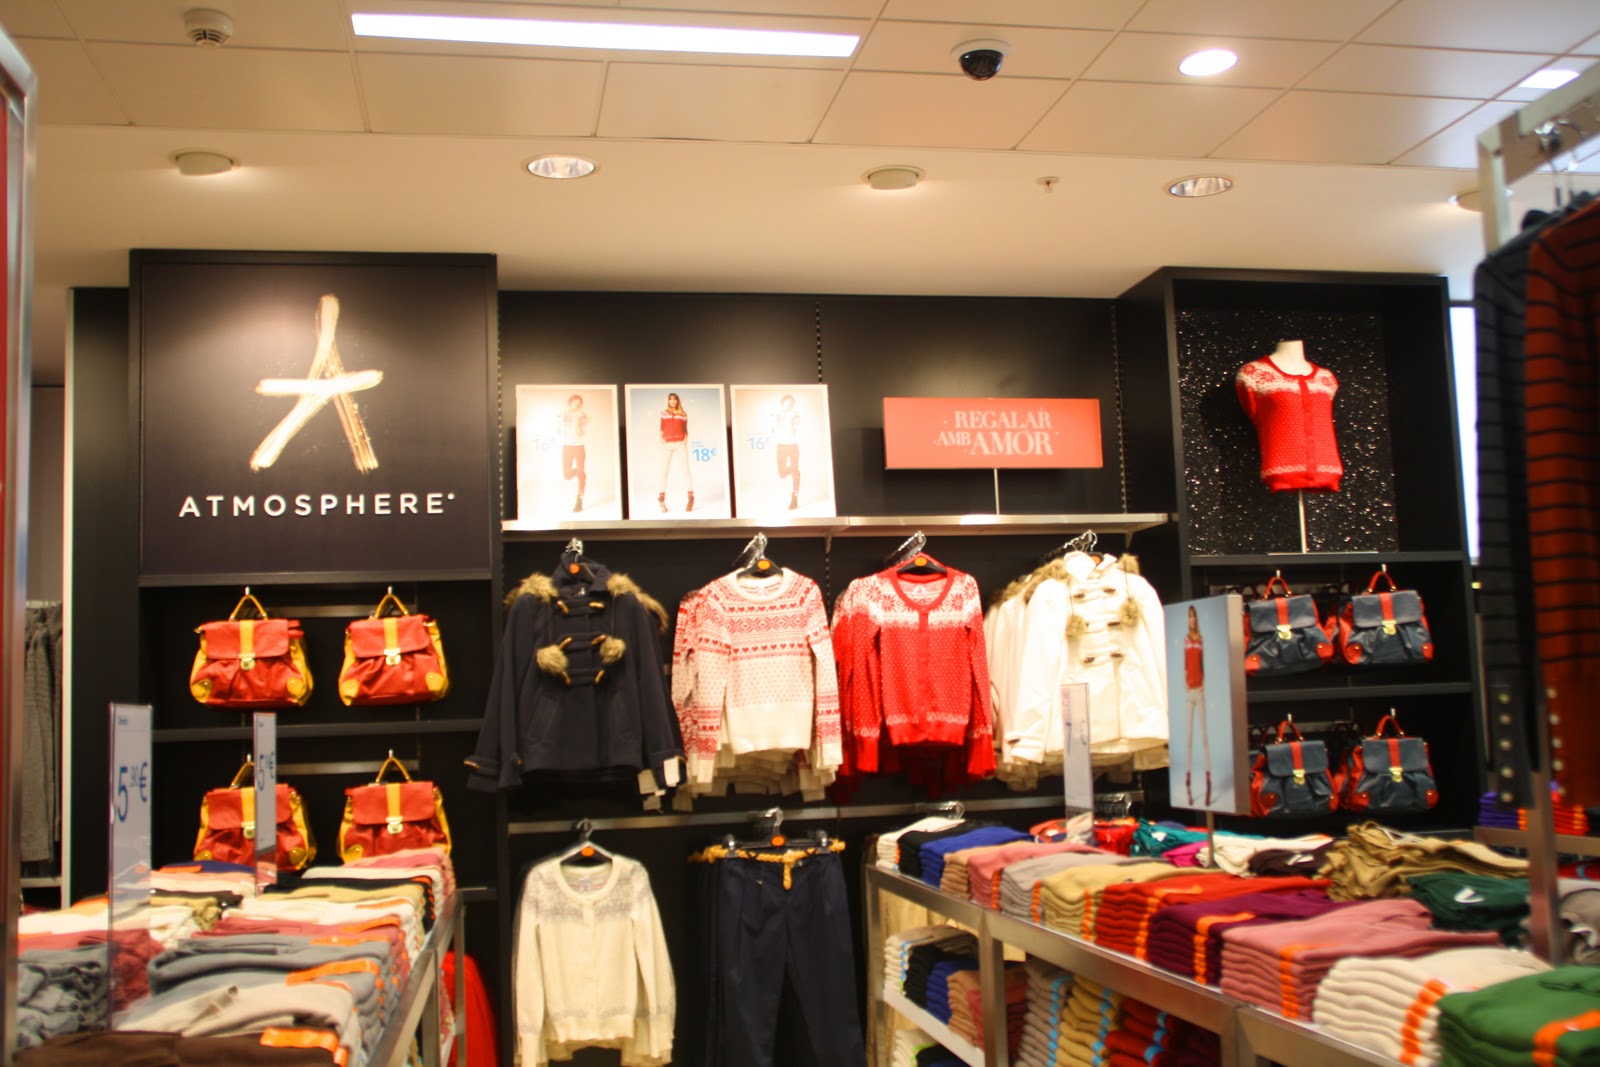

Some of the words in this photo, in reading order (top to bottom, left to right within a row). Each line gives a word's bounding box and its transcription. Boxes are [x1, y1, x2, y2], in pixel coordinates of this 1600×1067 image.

[953, 410, 1052, 429] REGALAR
[691, 447, 718, 462] 18€
[936, 431, 971, 447] AMB
[970, 431, 1054, 456] AMOR
[178, 492, 446, 518] ATMOSPHERE
